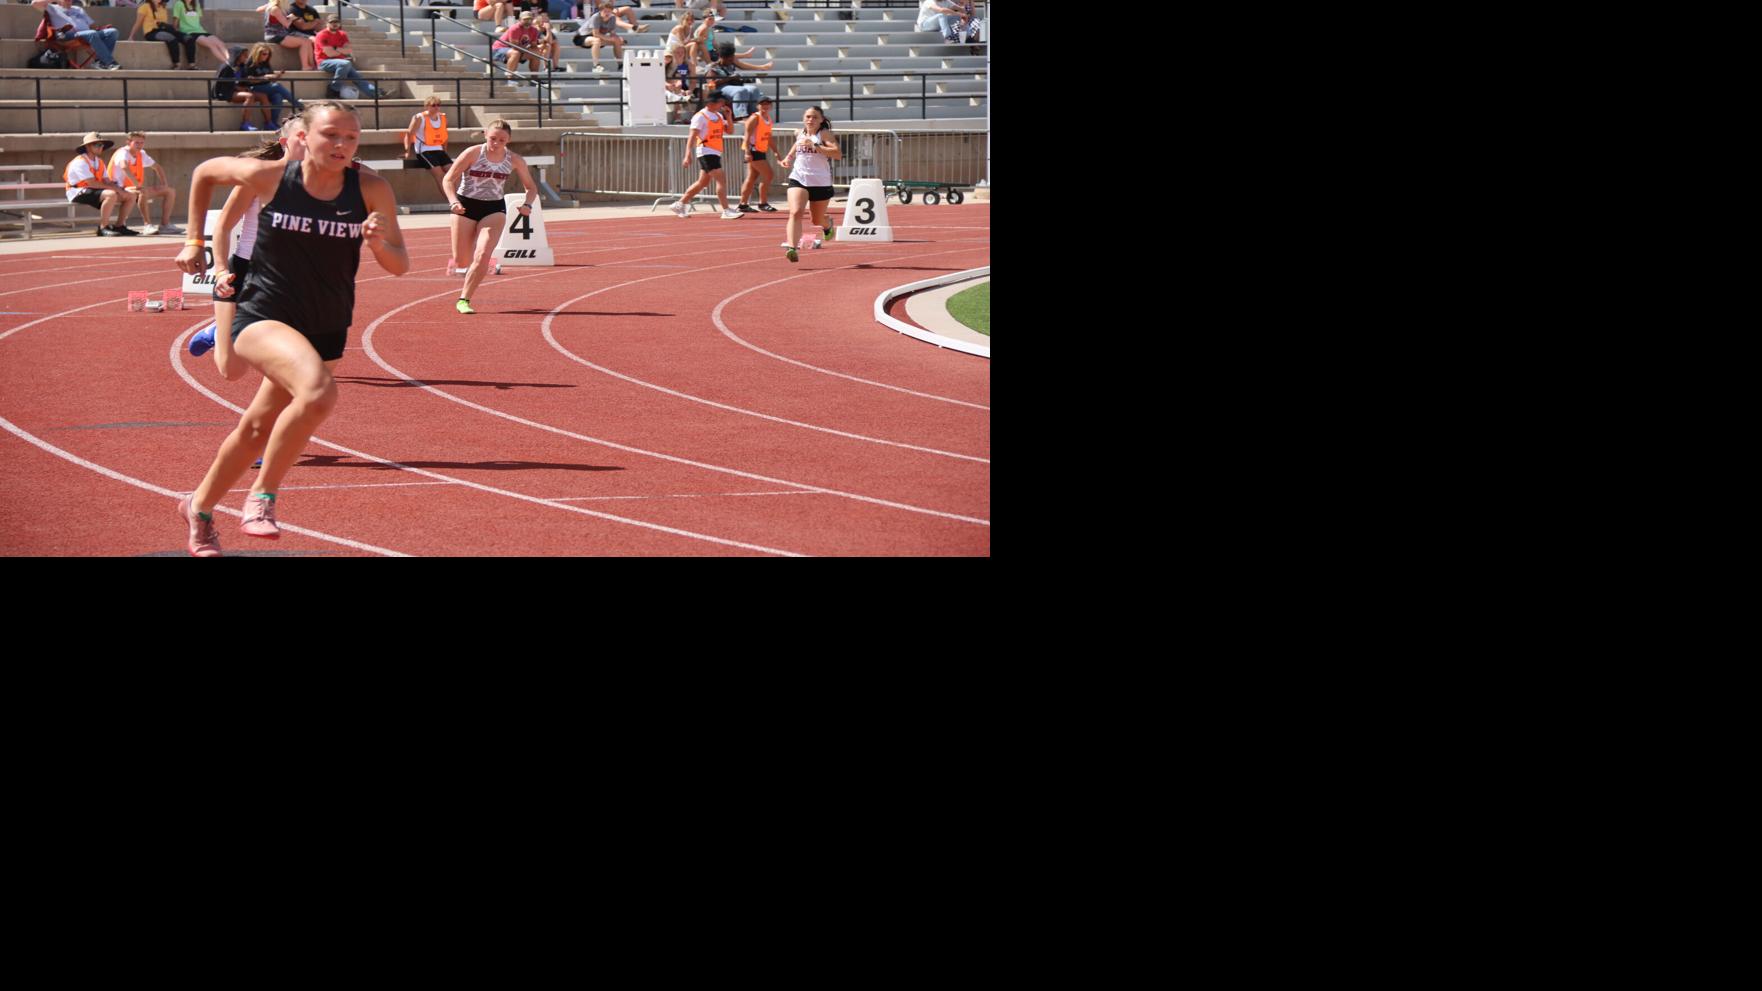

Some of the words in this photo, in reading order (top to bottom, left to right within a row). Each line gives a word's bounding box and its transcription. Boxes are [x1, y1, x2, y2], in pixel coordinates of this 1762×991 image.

[855, 197, 876, 225] 3
[271, 212, 313, 233] PINE
[318, 219, 362, 239] VIEW
[509, 213, 534, 240] 4
[849, 227, 878, 236] GILL
[503, 249, 537, 259] GILL
